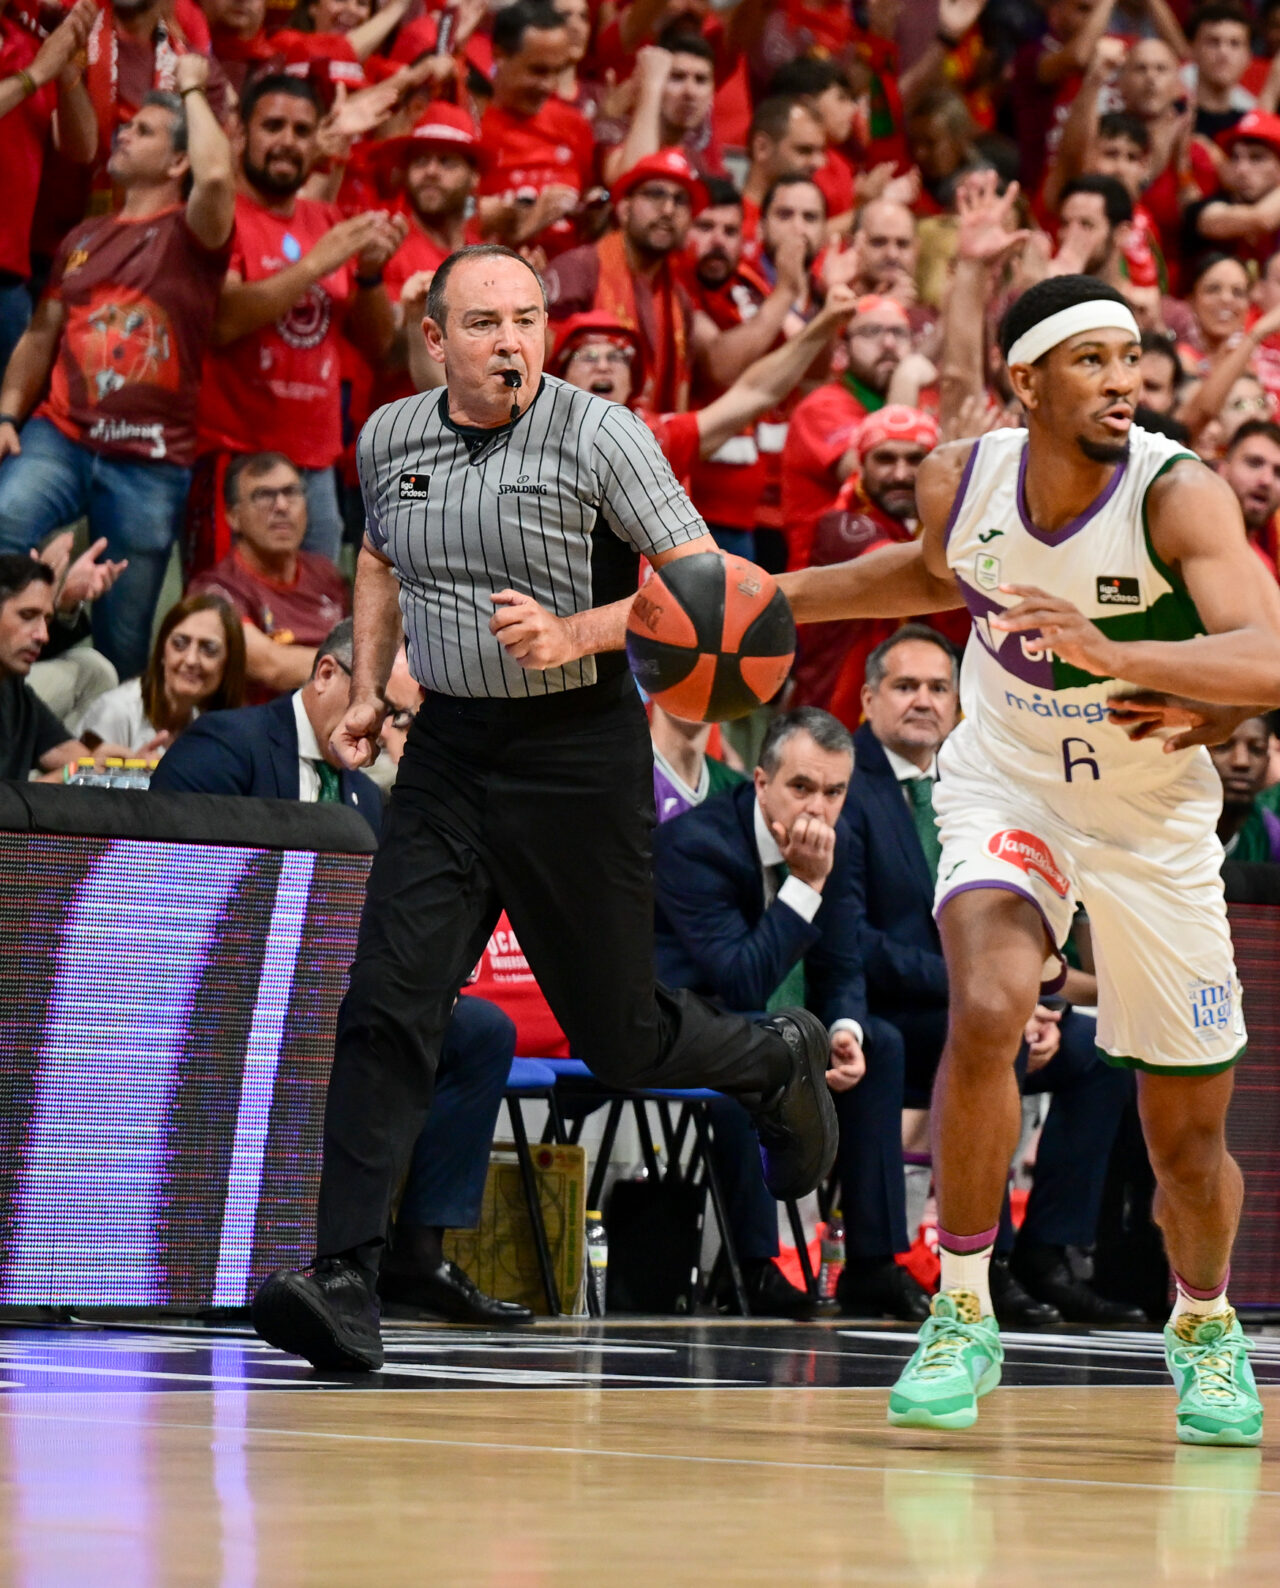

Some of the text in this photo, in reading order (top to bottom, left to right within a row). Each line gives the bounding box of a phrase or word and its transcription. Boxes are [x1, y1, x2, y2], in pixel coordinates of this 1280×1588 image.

[401, 481, 413, 489] liga
[498, 484, 548, 496] SPALDING
[401, 489, 427, 498] endesa
[1099, 584, 1119, 594] liga
[1100, 592, 1139, 603] endesa
